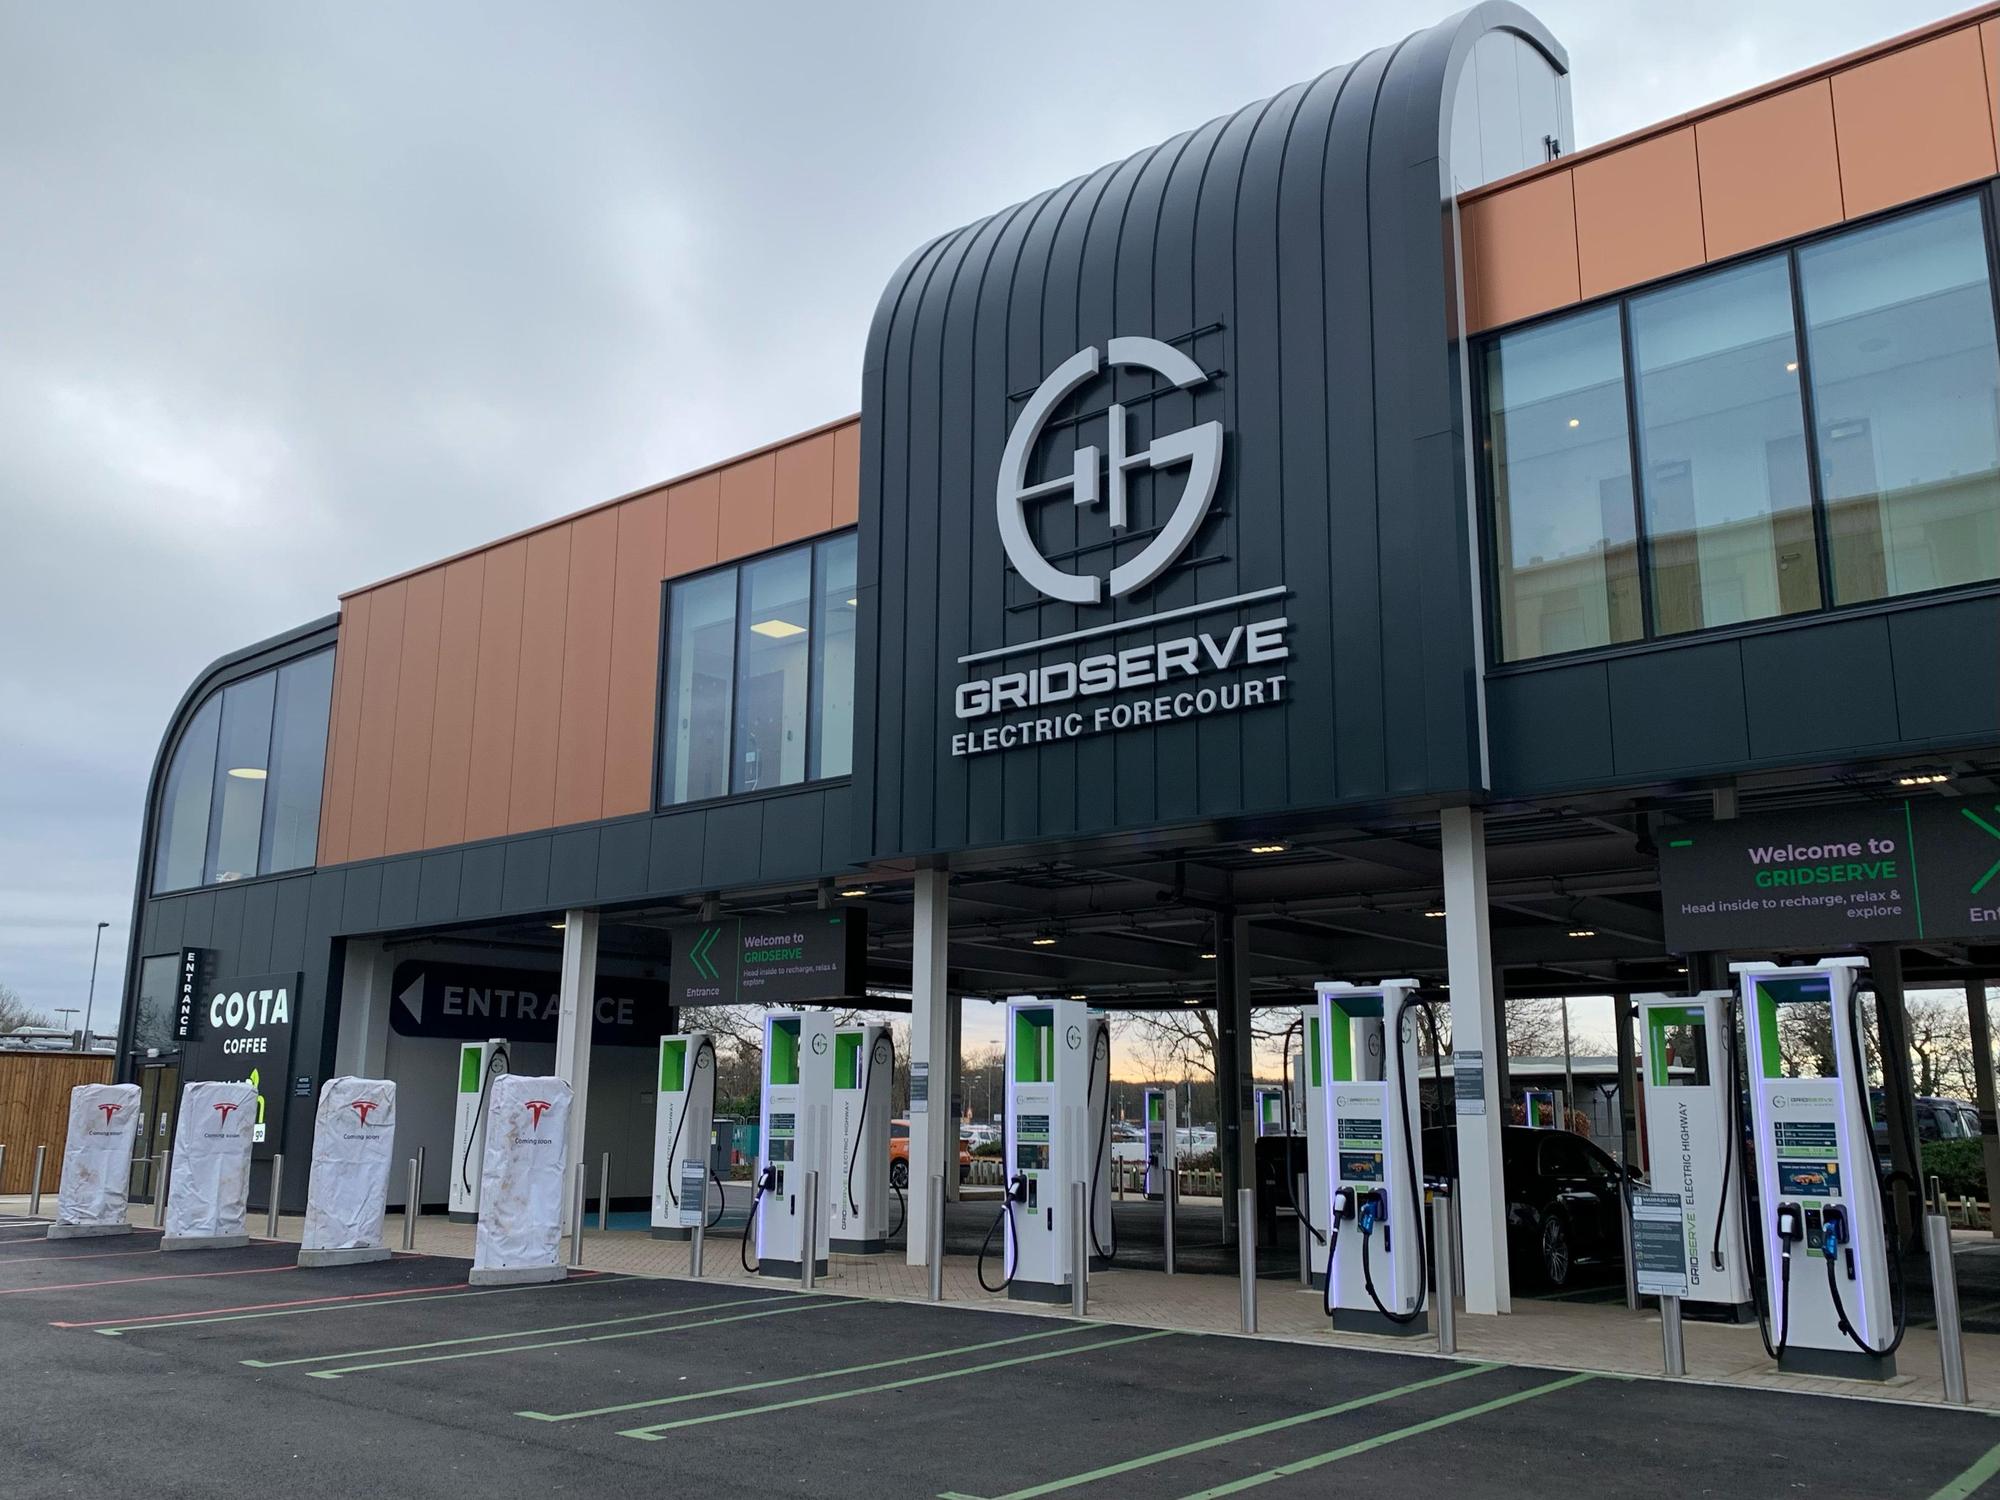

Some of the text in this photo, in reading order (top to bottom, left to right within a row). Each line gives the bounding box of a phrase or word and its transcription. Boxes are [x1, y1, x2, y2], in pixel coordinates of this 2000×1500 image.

[955, 617, 1288, 719] GRIDSERVE
[952, 676, 1286, 756] ELECTRIC FORECOURT
[1748, 837, 1895, 864] Welcome to
[1754, 861, 1898, 888] GRIDSERVE
[1681, 889, 1900, 914] Head inside to recharge, relax &
[1847, 903, 1901, 918] explore
[744, 932, 804, 948] Welcome to
[744, 948, 802, 963] GRIDSERVE
[743, 968, 759, 977] Head
[760, 966, 777, 976] inside
[778, 966, 785, 974] to
[815, 963, 831, 972] relax
[743, 978, 765, 987] explore
[179, 952, 195, 1036] ENTRANCE
[686, 987, 720, 997] Entrance
[209, 988, 288, 1031] COSTA
[443, 985, 634, 1025] ENTRACE
[223, 1037, 268, 1054] COFFEE
[515, 1137, 537, 1145] Coming
[1678, 1102, 1699, 1285] GRIDSERVE ELECTRIC HIGHWAY
